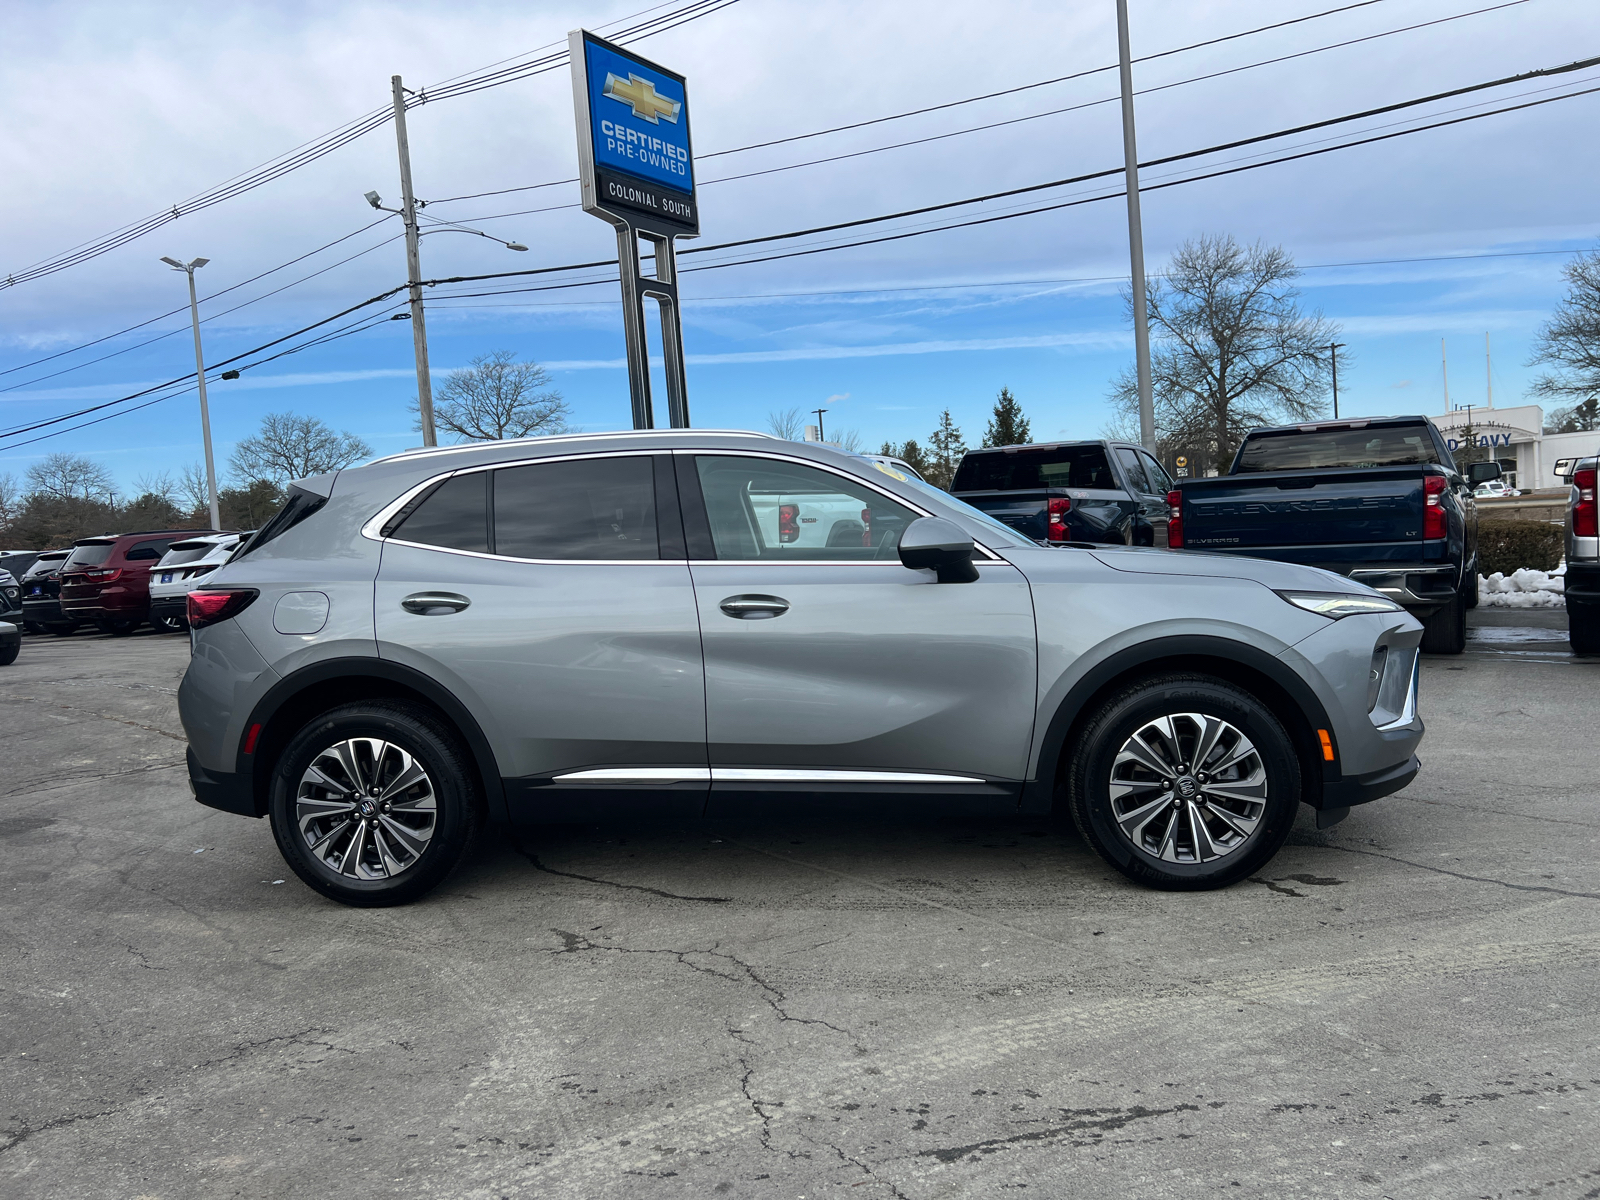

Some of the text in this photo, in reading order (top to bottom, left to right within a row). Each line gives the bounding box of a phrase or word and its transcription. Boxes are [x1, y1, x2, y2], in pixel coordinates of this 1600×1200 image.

[601, 120, 688, 162] CERTIFIED
[607, 137, 686, 176] PRE-OWNED
[609, 182, 691, 218] COLONIAL SOUTH
[1196, 496, 1405, 517] CHEVROLET
